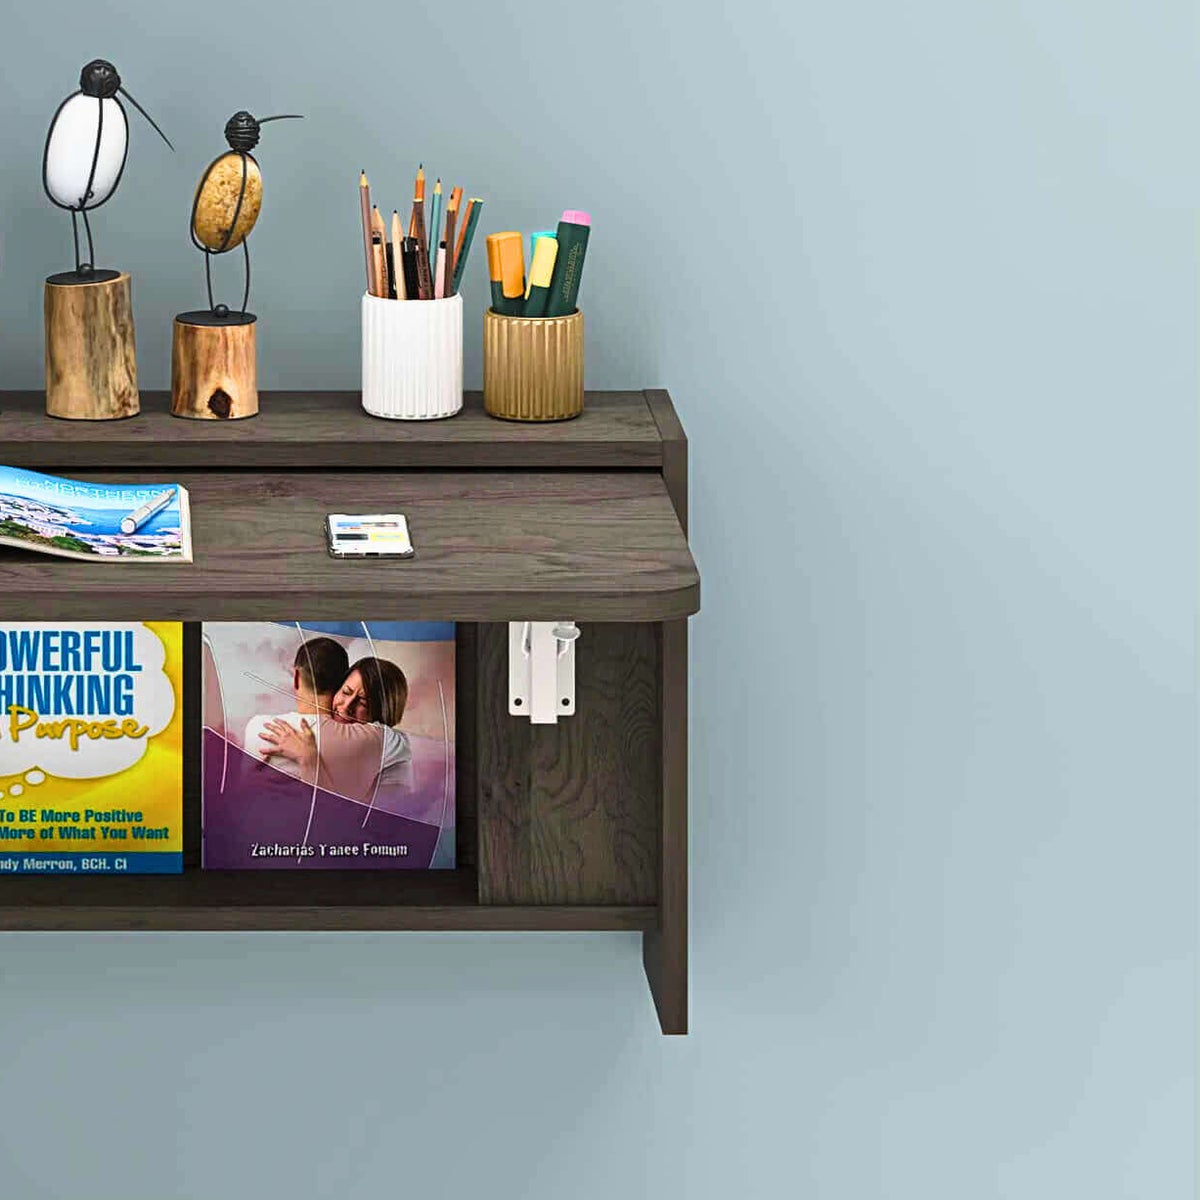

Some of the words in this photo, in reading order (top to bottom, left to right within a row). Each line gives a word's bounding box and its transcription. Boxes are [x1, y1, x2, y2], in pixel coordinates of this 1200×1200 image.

[7, 704, 149, 751] Purpose
[19, 809, 36, 823] BE
[41, 809, 80, 823] More
[84, 809, 143, 823] Positive
[40, 826, 54, 840] of
[58, 826, 96, 840] What
[101, 826, 127, 840] You
[132, 826, 169, 840] Want
[252, 842, 315, 857] Zacharias
[363, 843, 407, 856] Fomum
[23, 858, 77, 871] Merron,
